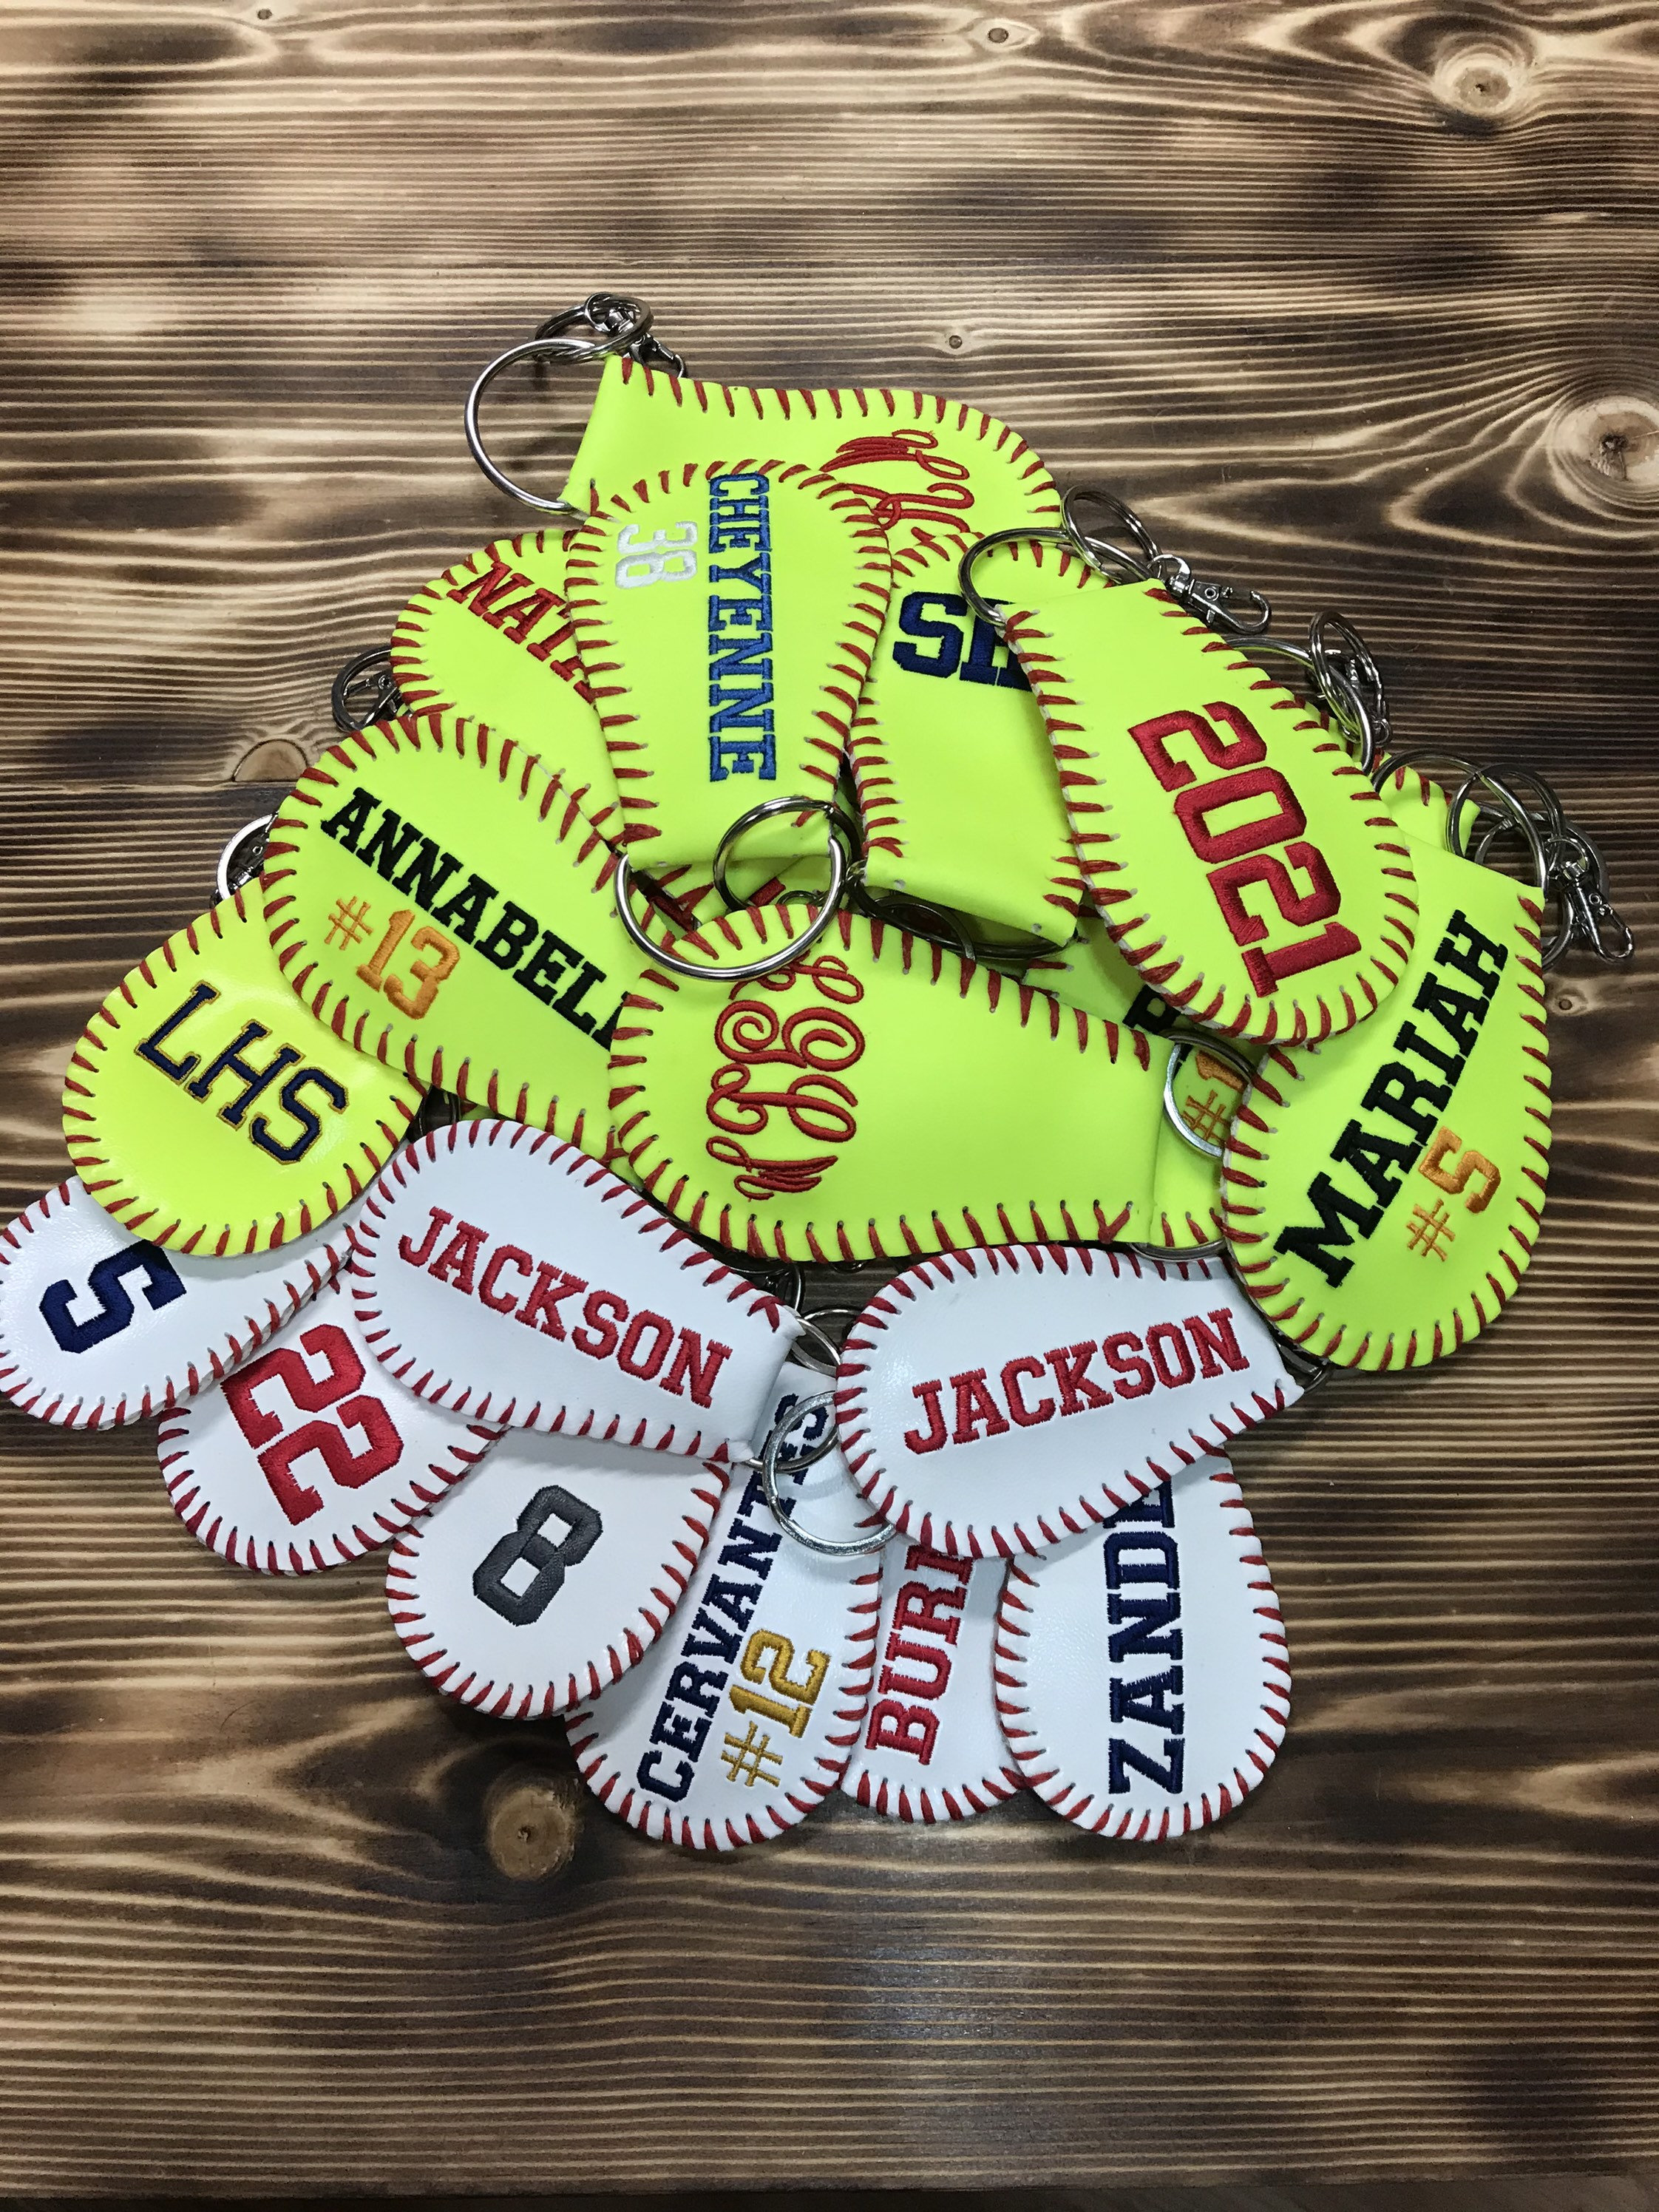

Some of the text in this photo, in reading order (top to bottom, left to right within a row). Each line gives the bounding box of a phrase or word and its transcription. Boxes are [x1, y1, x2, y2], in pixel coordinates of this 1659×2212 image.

[615, 520, 697, 588] 38
[708, 472, 776, 782] CHEYENNE
[1128, 701, 1362, 998] 2021
[325, 895, 461, 1020] #13
[135, 980, 350, 1165] LHS
[1274, 909, 1508, 1288] MARIAH
[1406, 1126, 1502, 1261] #5
[398, 1206, 733, 1409] JACKSON
[903, 1309, 1250, 1455] JACKSON
[222, 1323, 404, 1526] 22
[472, 1485, 603, 1626] 8
[721, 1628, 832, 1787] #12
